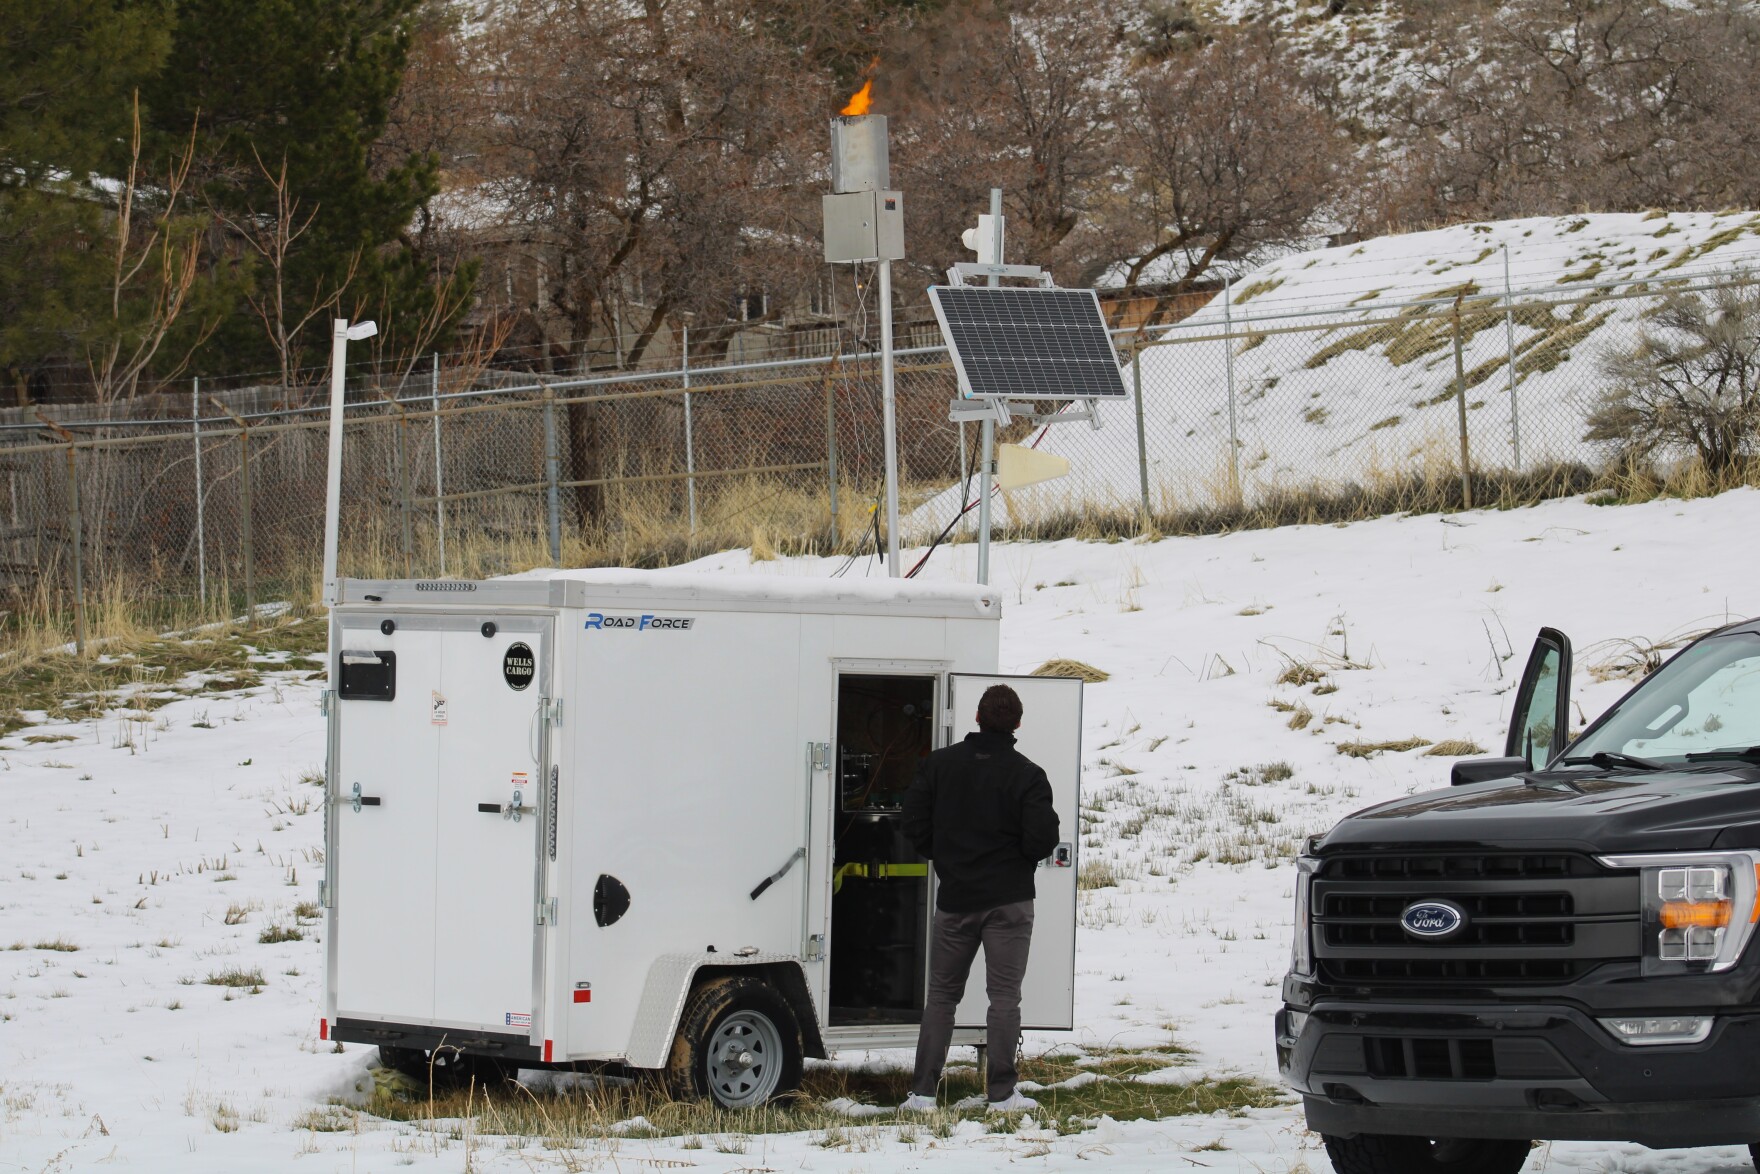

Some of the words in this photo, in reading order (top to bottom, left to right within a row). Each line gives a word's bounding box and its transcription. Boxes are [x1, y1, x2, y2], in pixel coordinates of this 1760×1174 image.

[585, 613, 635, 629] ROAD
[639, 615, 690, 631] FORCE
[507, 657, 532, 666] WELLS
[506, 666, 532, 675] CARGO
[1413, 909, 1445, 928] Ford
